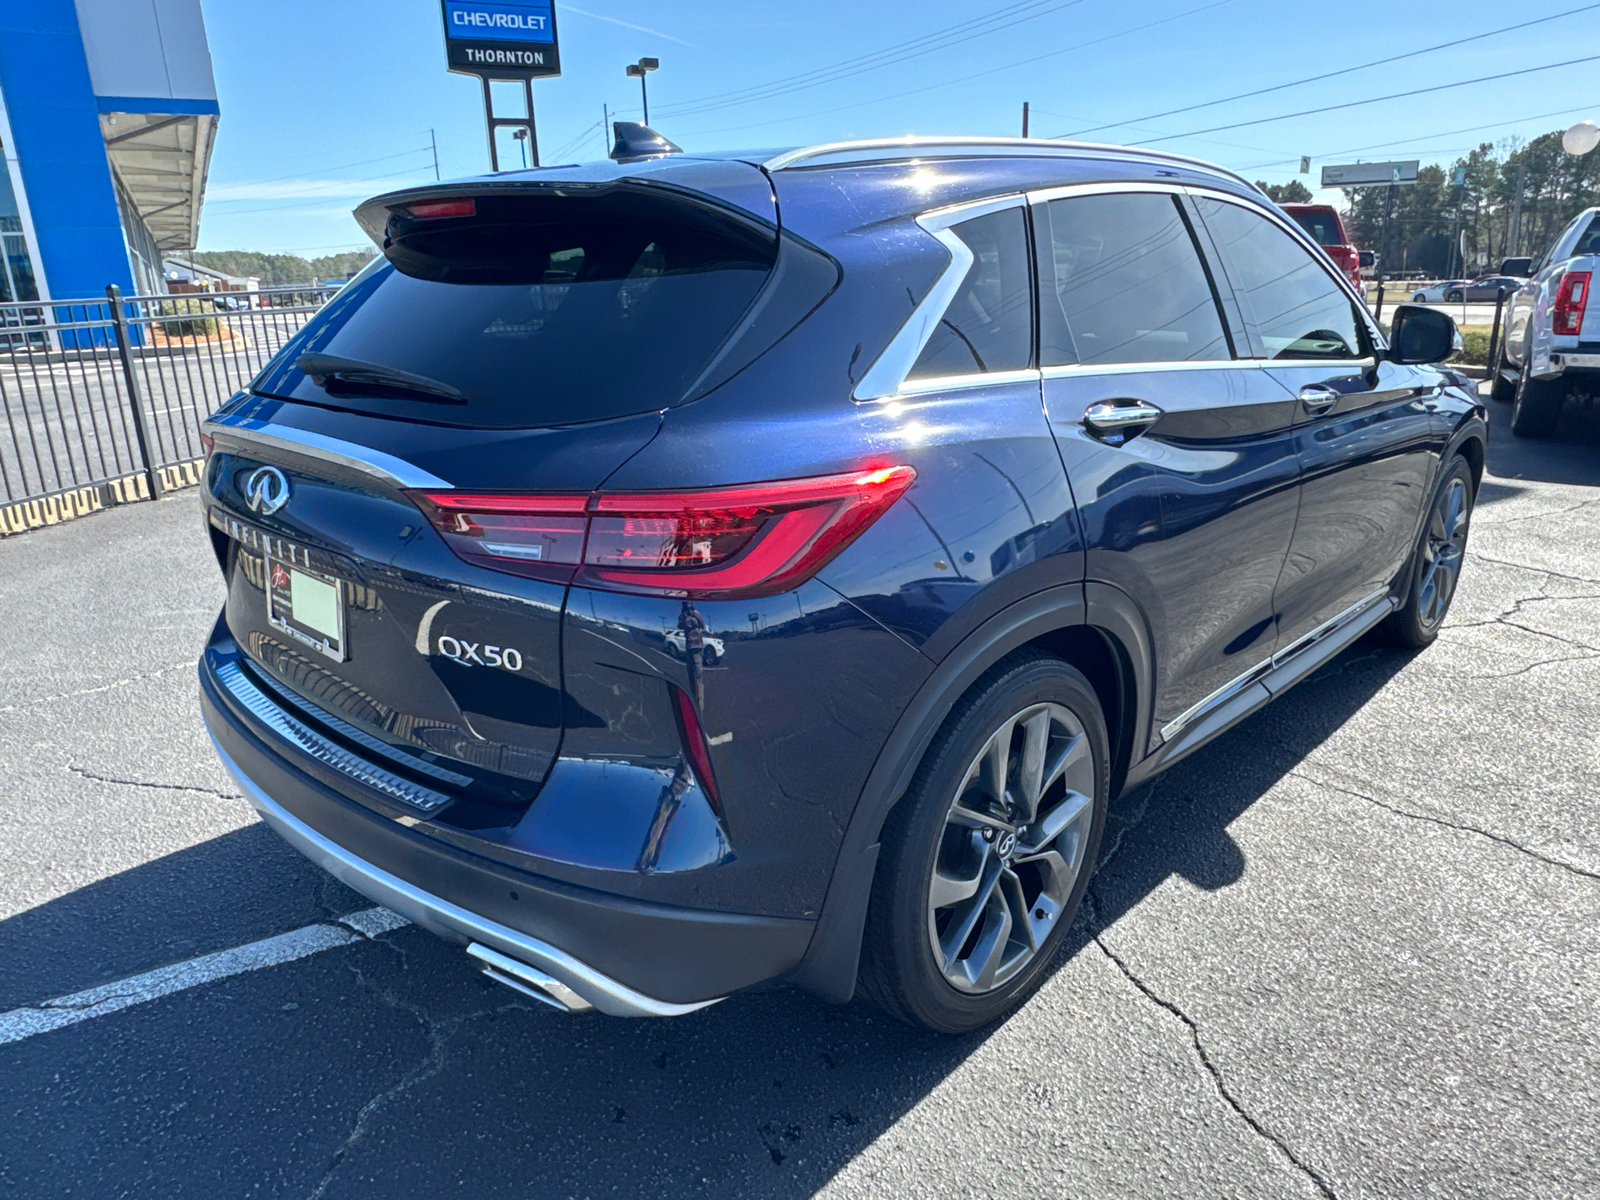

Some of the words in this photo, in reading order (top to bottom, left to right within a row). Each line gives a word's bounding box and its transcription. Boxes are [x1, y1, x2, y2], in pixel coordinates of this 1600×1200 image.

[453, 11, 546, 29] CHEVROLET
[465, 49, 544, 64] THORNTON
[224, 517, 310, 567] INFINITI
[438, 636, 522, 671] QX50
